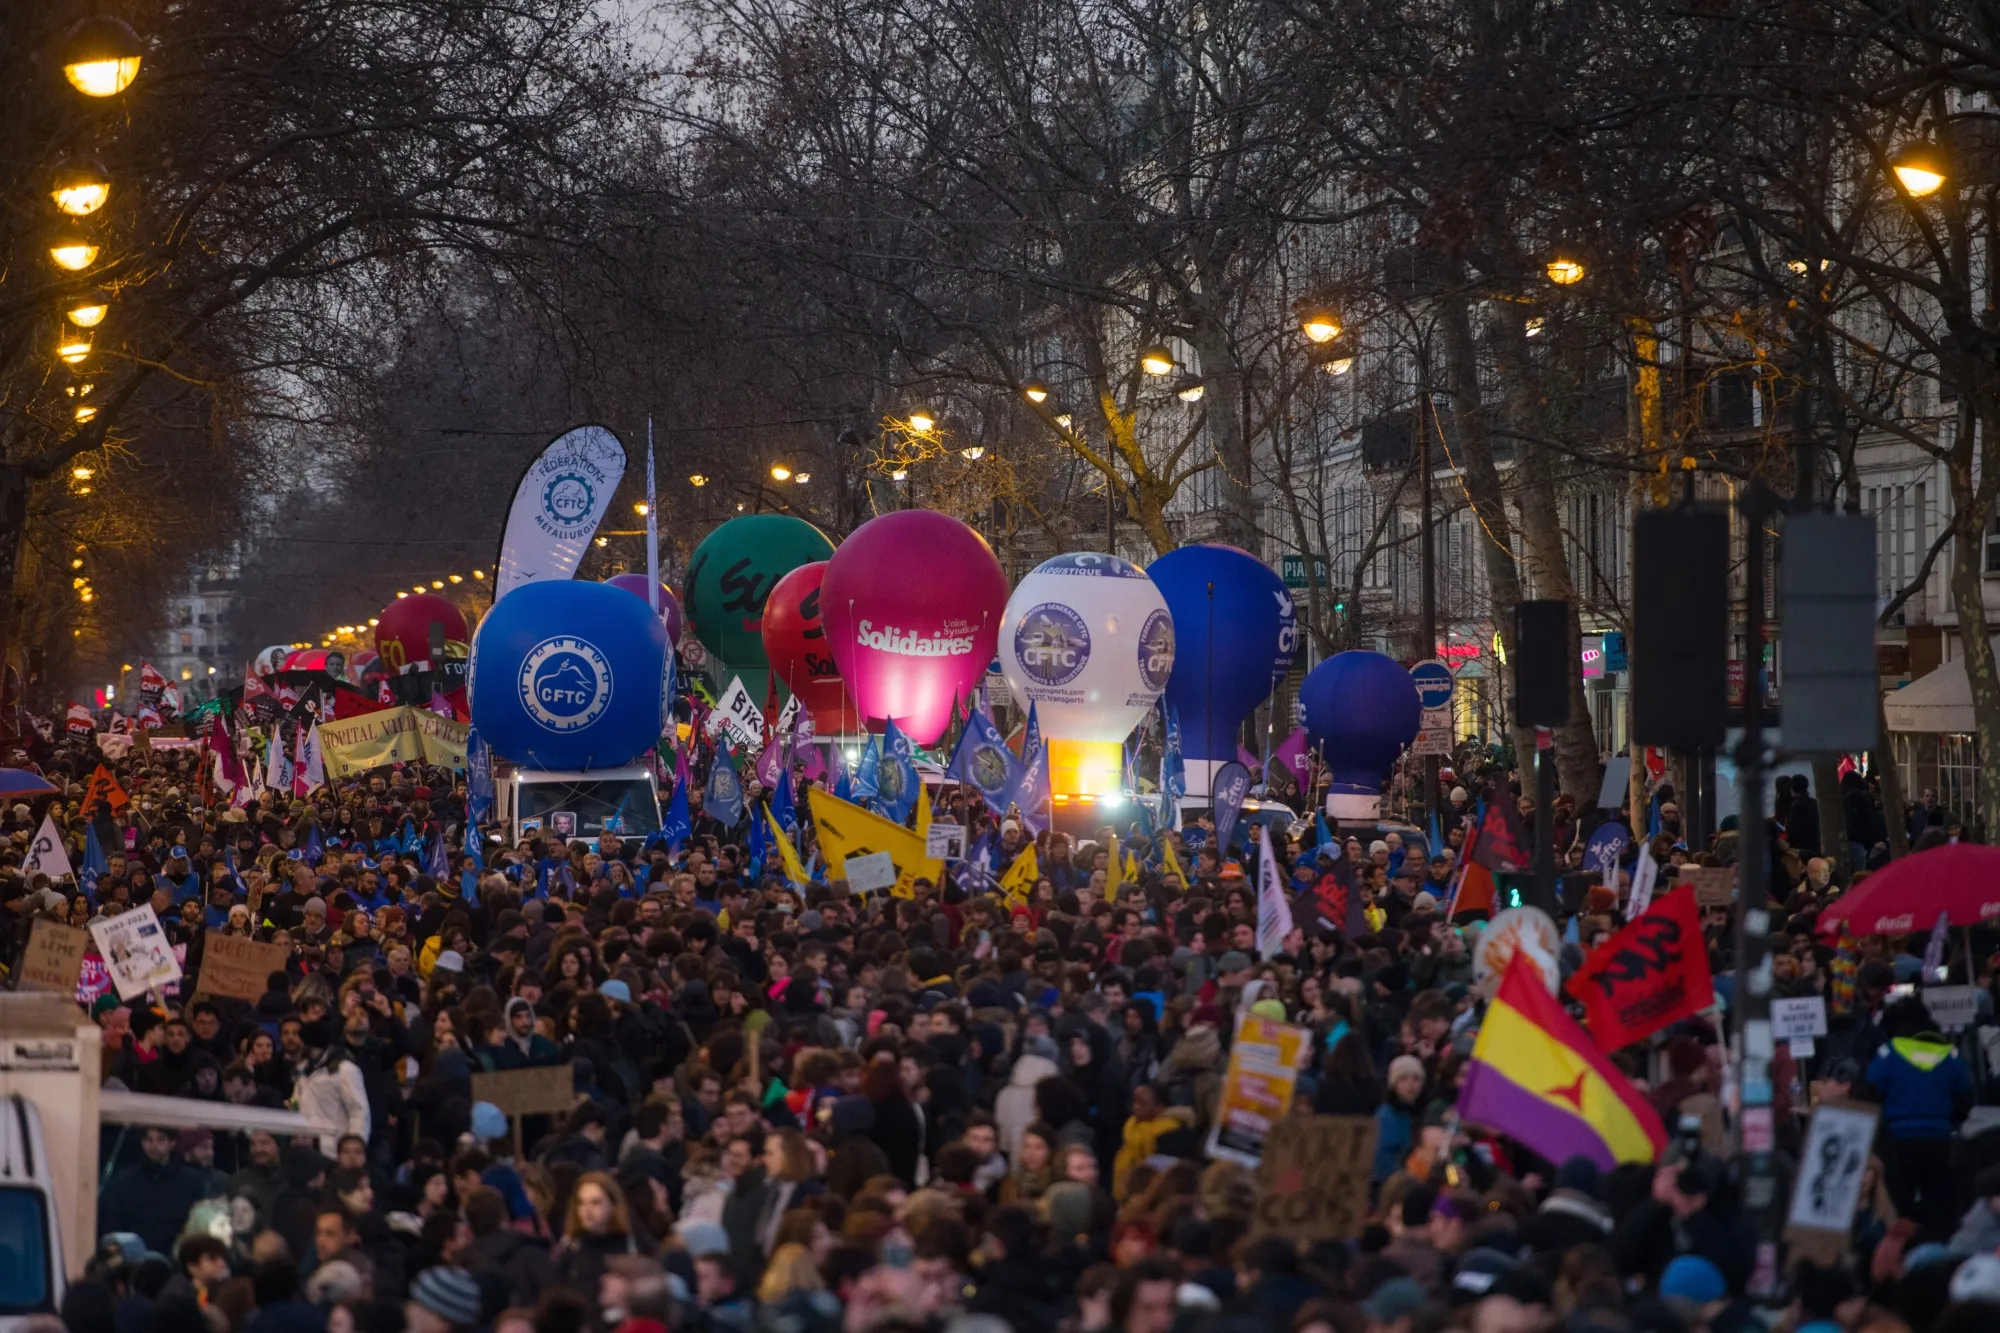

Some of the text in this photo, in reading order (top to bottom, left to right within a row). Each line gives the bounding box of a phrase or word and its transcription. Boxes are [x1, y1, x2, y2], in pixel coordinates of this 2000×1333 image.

[556, 498, 586, 510] CFTC
[857, 619, 975, 657] Solidaires
[1023, 647, 1076, 669] CFTC
[1049, 695, 1085, 704] transports
[68, 723, 90, 735] CNT
